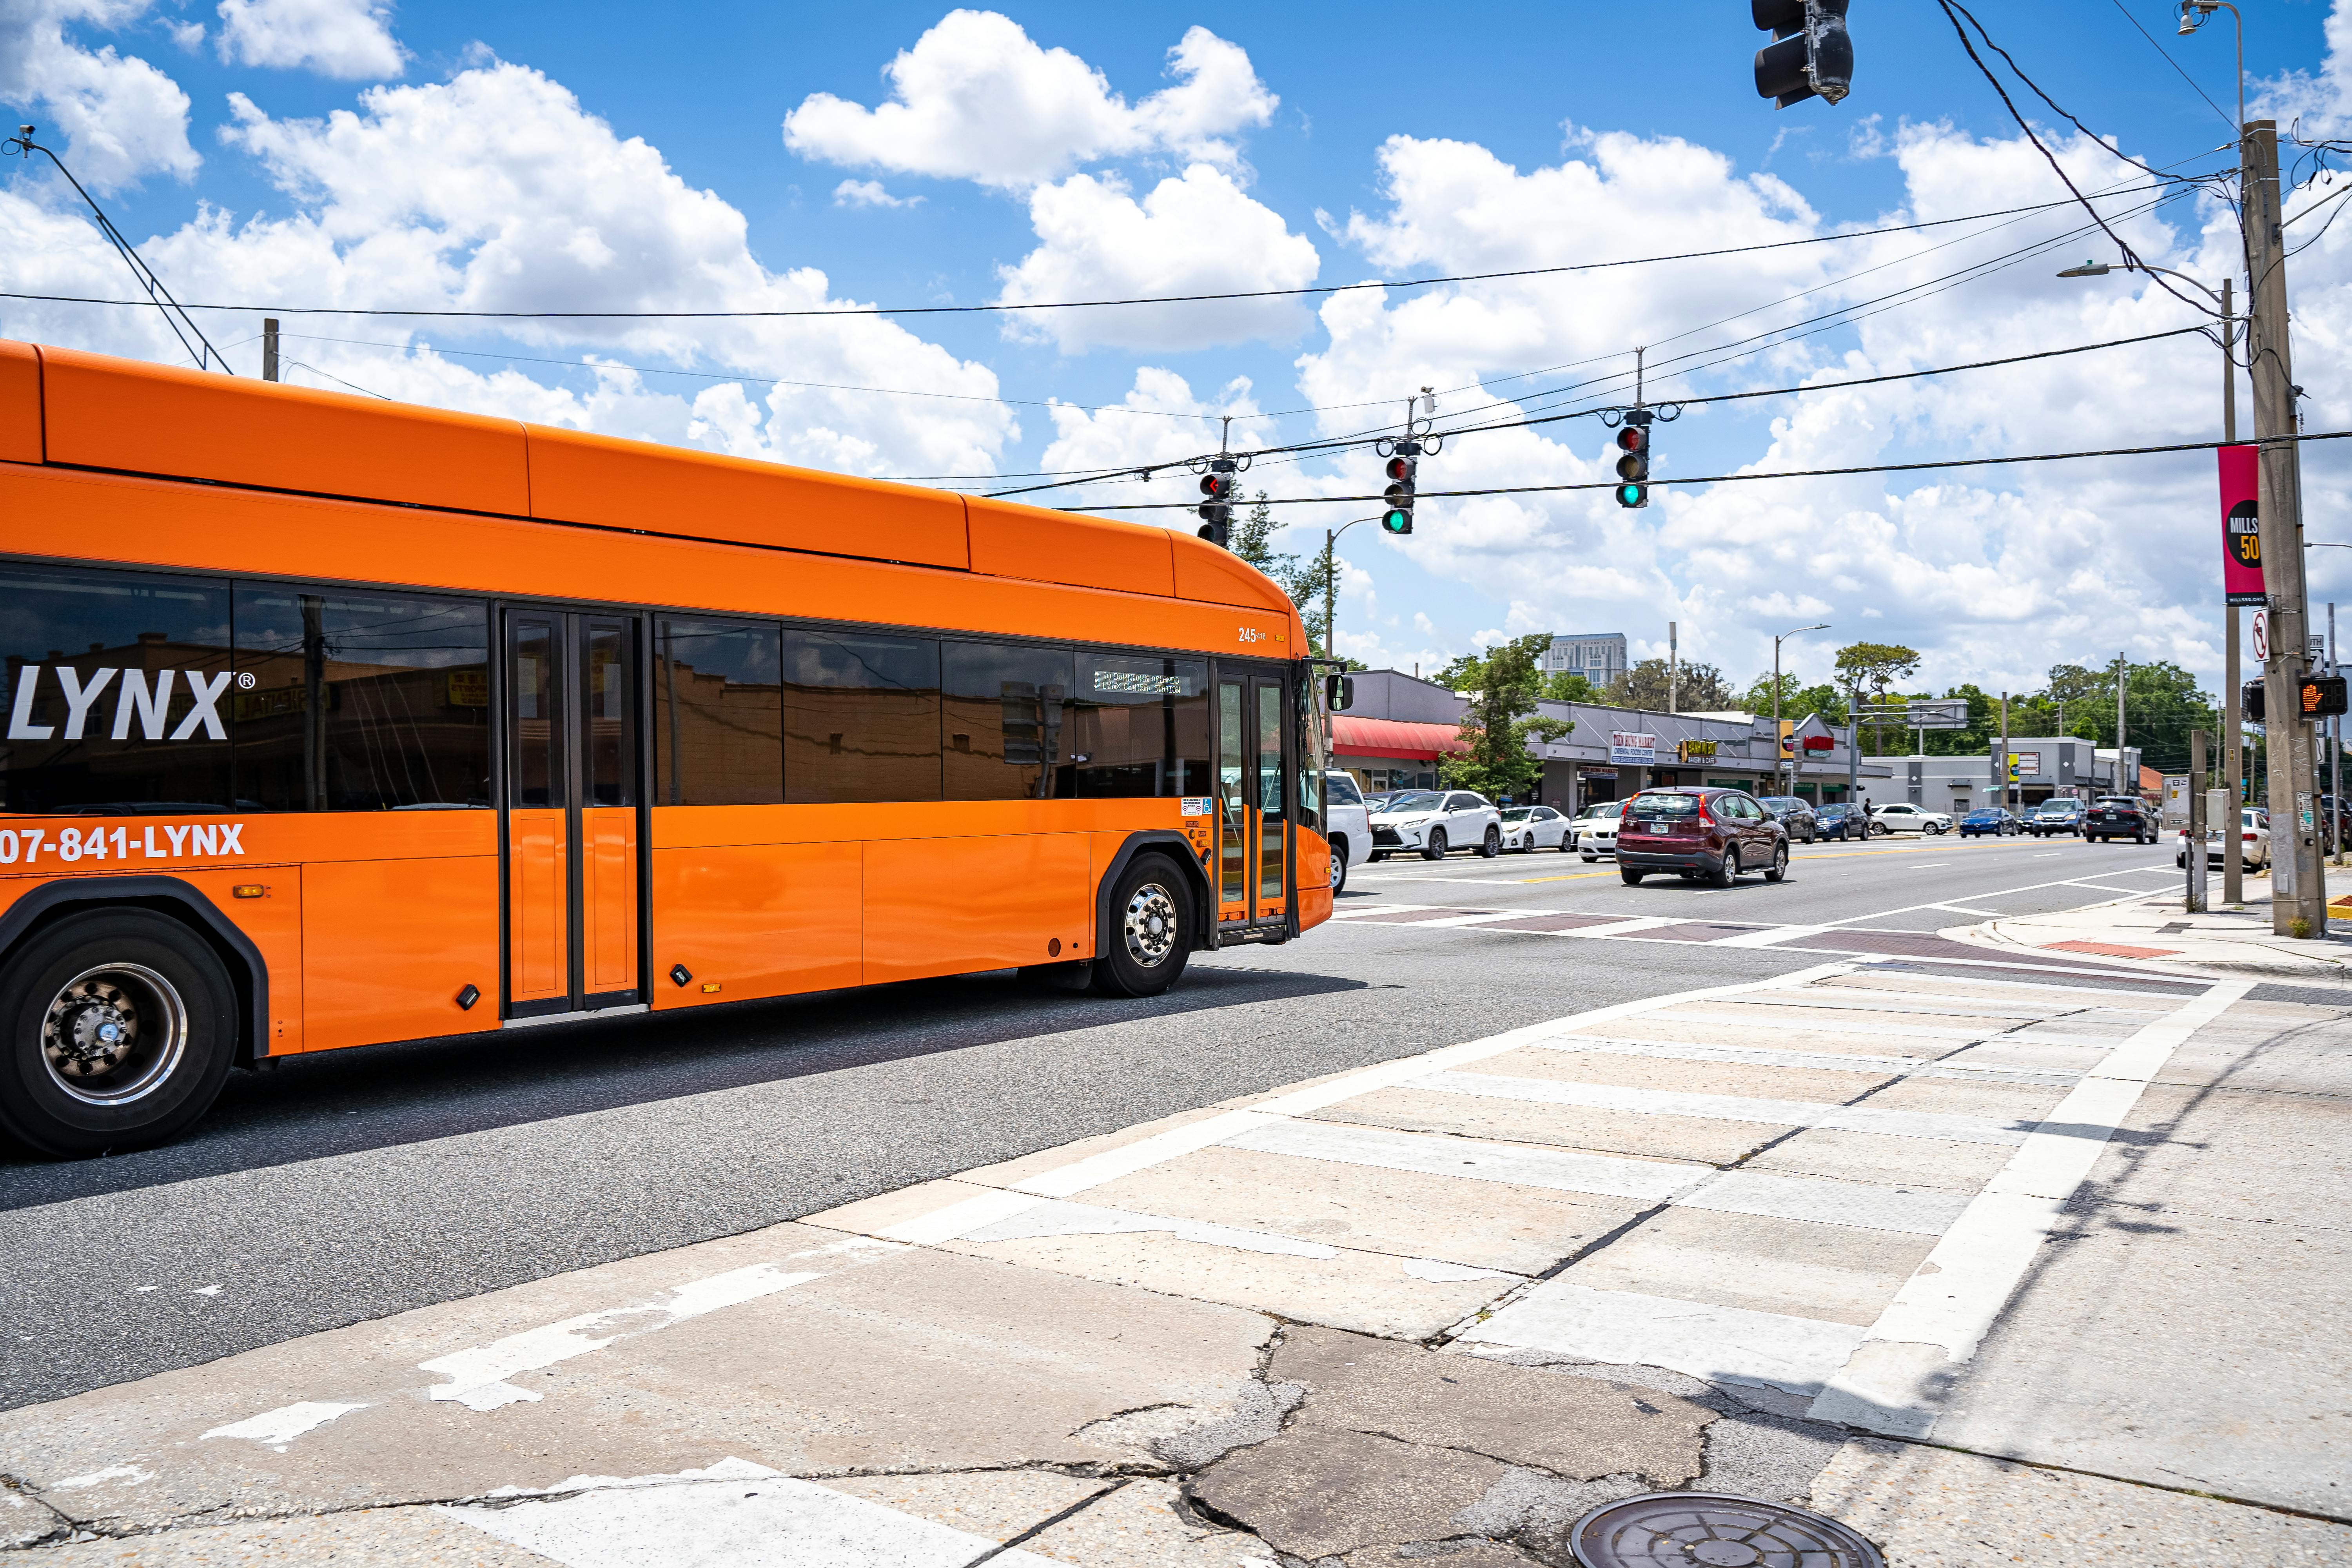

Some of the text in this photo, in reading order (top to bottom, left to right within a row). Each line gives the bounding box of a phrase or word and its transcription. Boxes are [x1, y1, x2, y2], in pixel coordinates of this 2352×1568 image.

[2230, 517, 2258, 534] MILLS
[2241, 535, 2260, 559] 50
[1114, 673, 1149, 682] DOWNTOWN
[1151, 675, 1180, 684] ORLANDO
[1102, 682, 1180, 694] LYNX CENTRAL STATION
[1638, 736, 1655, 748] MARKET
